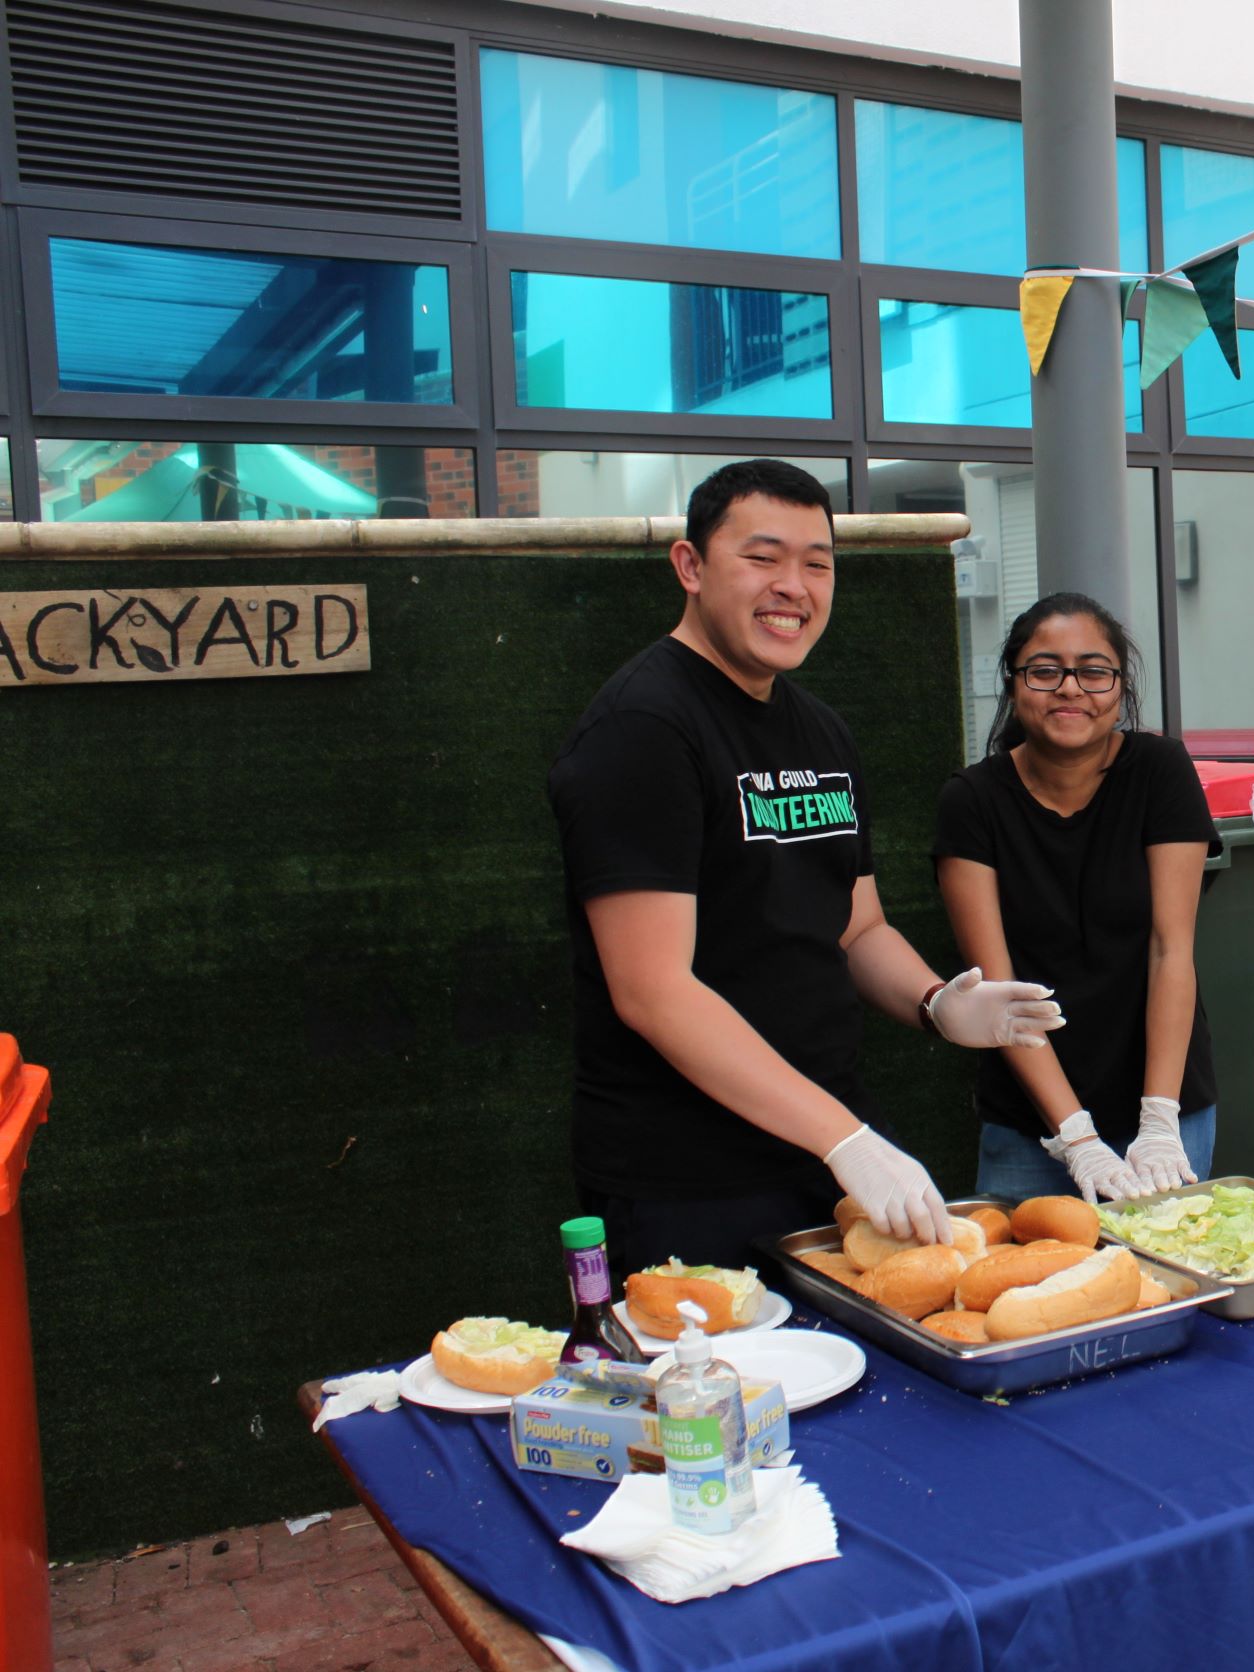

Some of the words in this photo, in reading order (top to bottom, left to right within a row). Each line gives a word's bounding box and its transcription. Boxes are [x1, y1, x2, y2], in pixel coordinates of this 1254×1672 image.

[779, 770, 818, 789] GUILD
[531, 1386, 570, 1398] 100
[524, 1418, 577, 1444] Powder
[578, 1425, 612, 1449] free
[526, 1446, 552, 1466] 100
